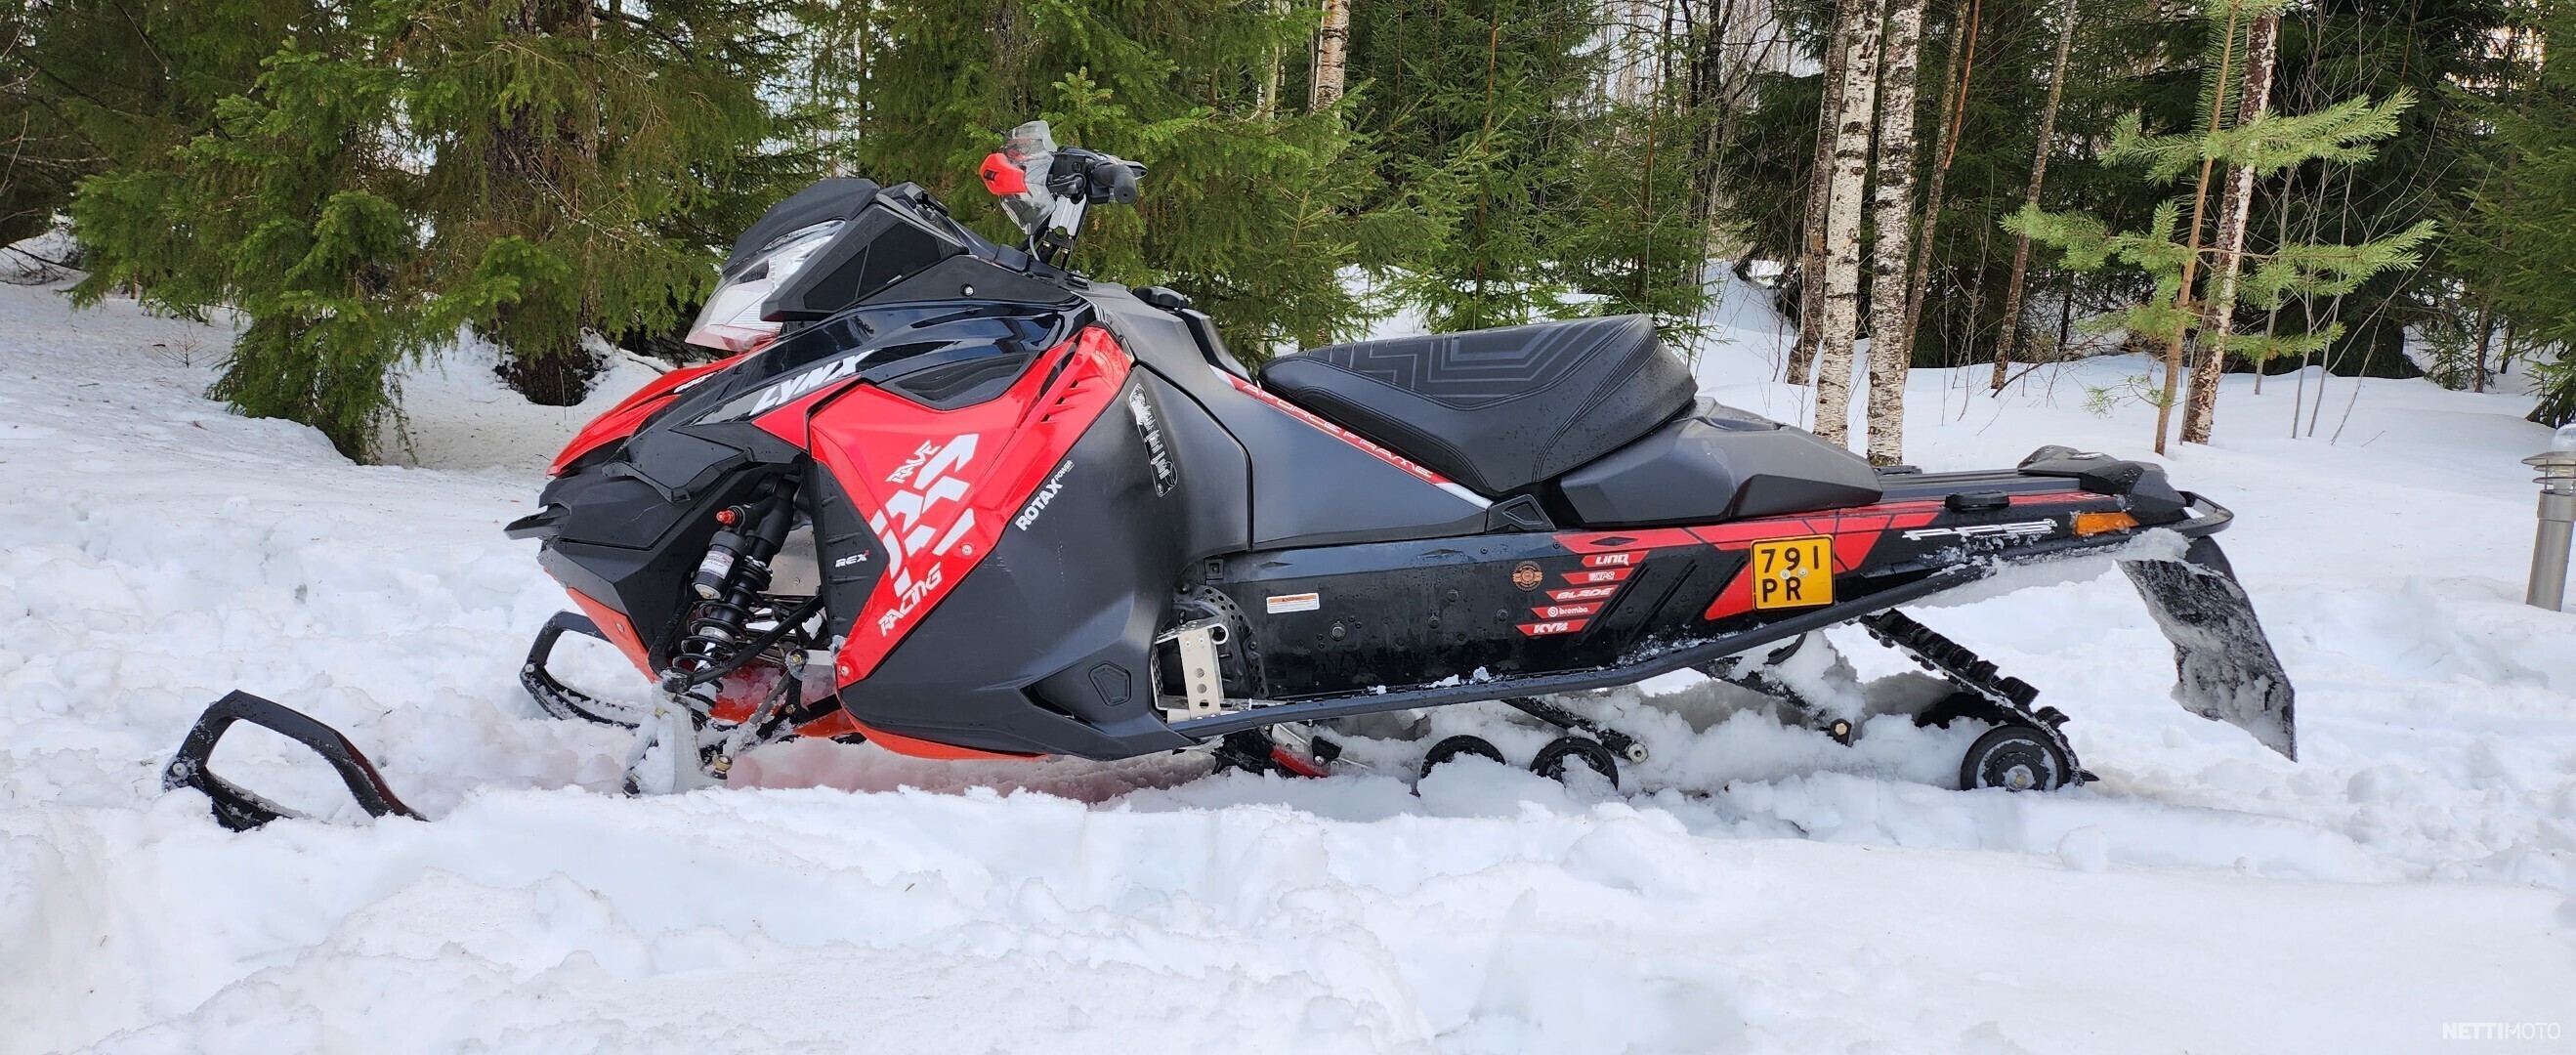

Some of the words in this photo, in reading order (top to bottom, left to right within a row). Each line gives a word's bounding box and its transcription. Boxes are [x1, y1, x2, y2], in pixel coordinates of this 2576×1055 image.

[748, 349, 874, 416] LYNX
[885, 440, 941, 484] RAVE
[1343, 431, 1433, 479] FRAME
[1015, 479, 1063, 531] ROTAX
[1054, 459, 1074, 482] POWER
[1760, 545, 1819, 573] 791
[878, 561, 942, 637] RACING
[1556, 587, 1614, 600] BLADE
[1762, 576, 1801, 603] PR
[1534, 621, 1568, 634] KYB
[1559, 607, 1589, 615] brembo
